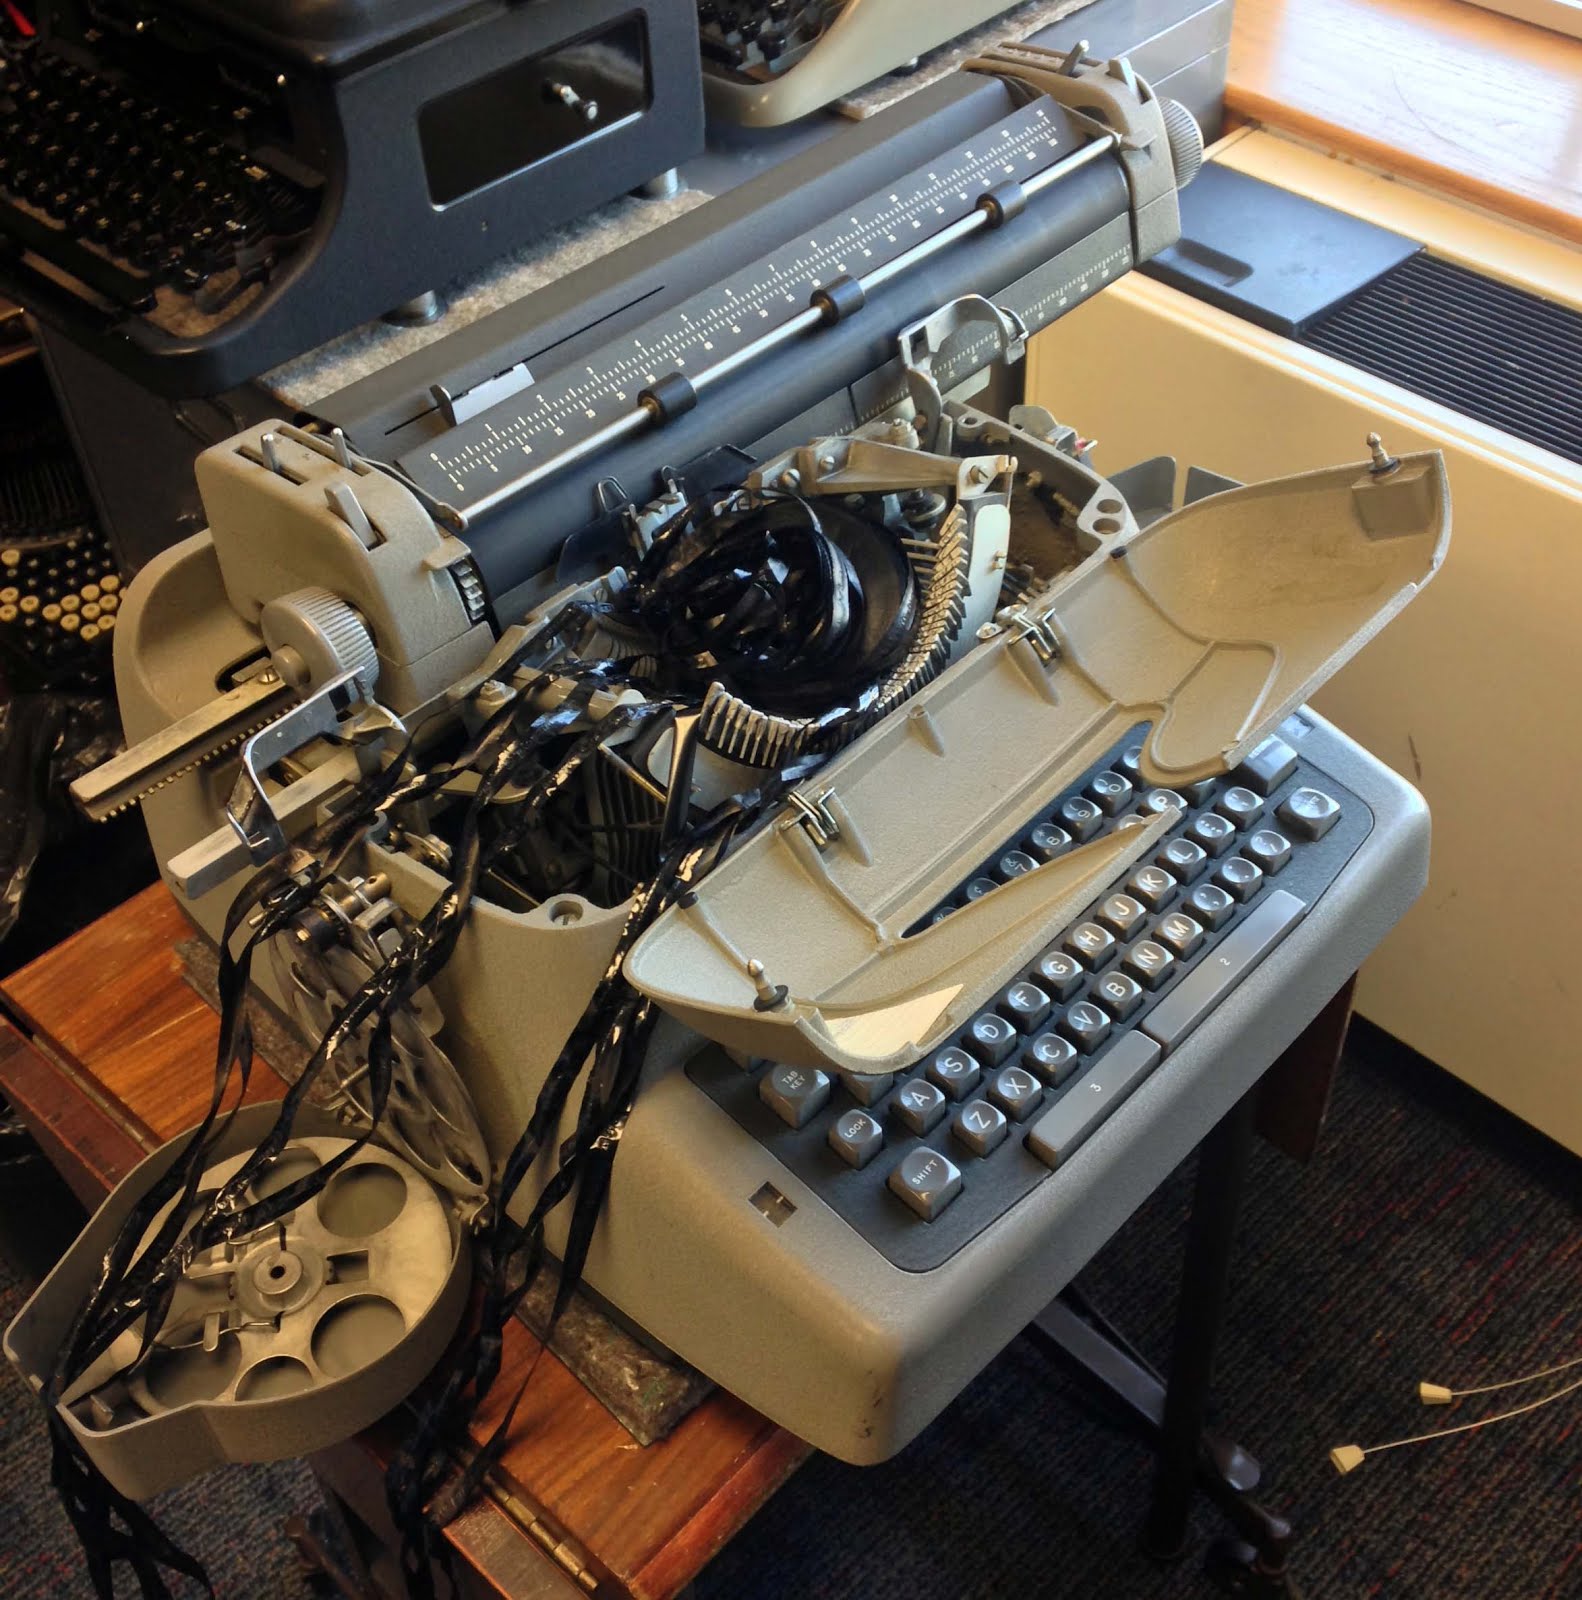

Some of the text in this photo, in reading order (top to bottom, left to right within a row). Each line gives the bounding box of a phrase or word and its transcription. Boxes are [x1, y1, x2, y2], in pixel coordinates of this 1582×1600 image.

[1154, 796, 1169, 809] P
[1077, 810, 1091, 819] 9
[1046, 836, 1061, 846] 8
[1171, 849, 1193, 860] L
[1141, 873, 1164, 888] K
[1114, 901, 1131, 916] J
[1167, 919, 1191, 938] M
[1077, 930, 1101, 947] H
[1136, 948, 1160, 965] N
[1219, 957, 1231, 967] 2
[1048, 960, 1069, 976] G
[1105, 982, 1126, 998] B
[1014, 990, 1030, 1008] F
[1073, 1009, 1094, 1025] V
[982, 1024, 1000, 1039] D
[1042, 1044, 1061, 1059] C
[944, 1057, 964, 1073] S
[789, 1074, 806, 1090] KEY
[1004, 1077, 1028, 1096] X
[1089, 1082, 1102, 1093] 3
[911, 1091, 931, 1107] A
[843, 1118, 867, 1138] LOCK
[969, 1111, 992, 1129] Z
[911, 1159, 939, 1186] SHIFT
